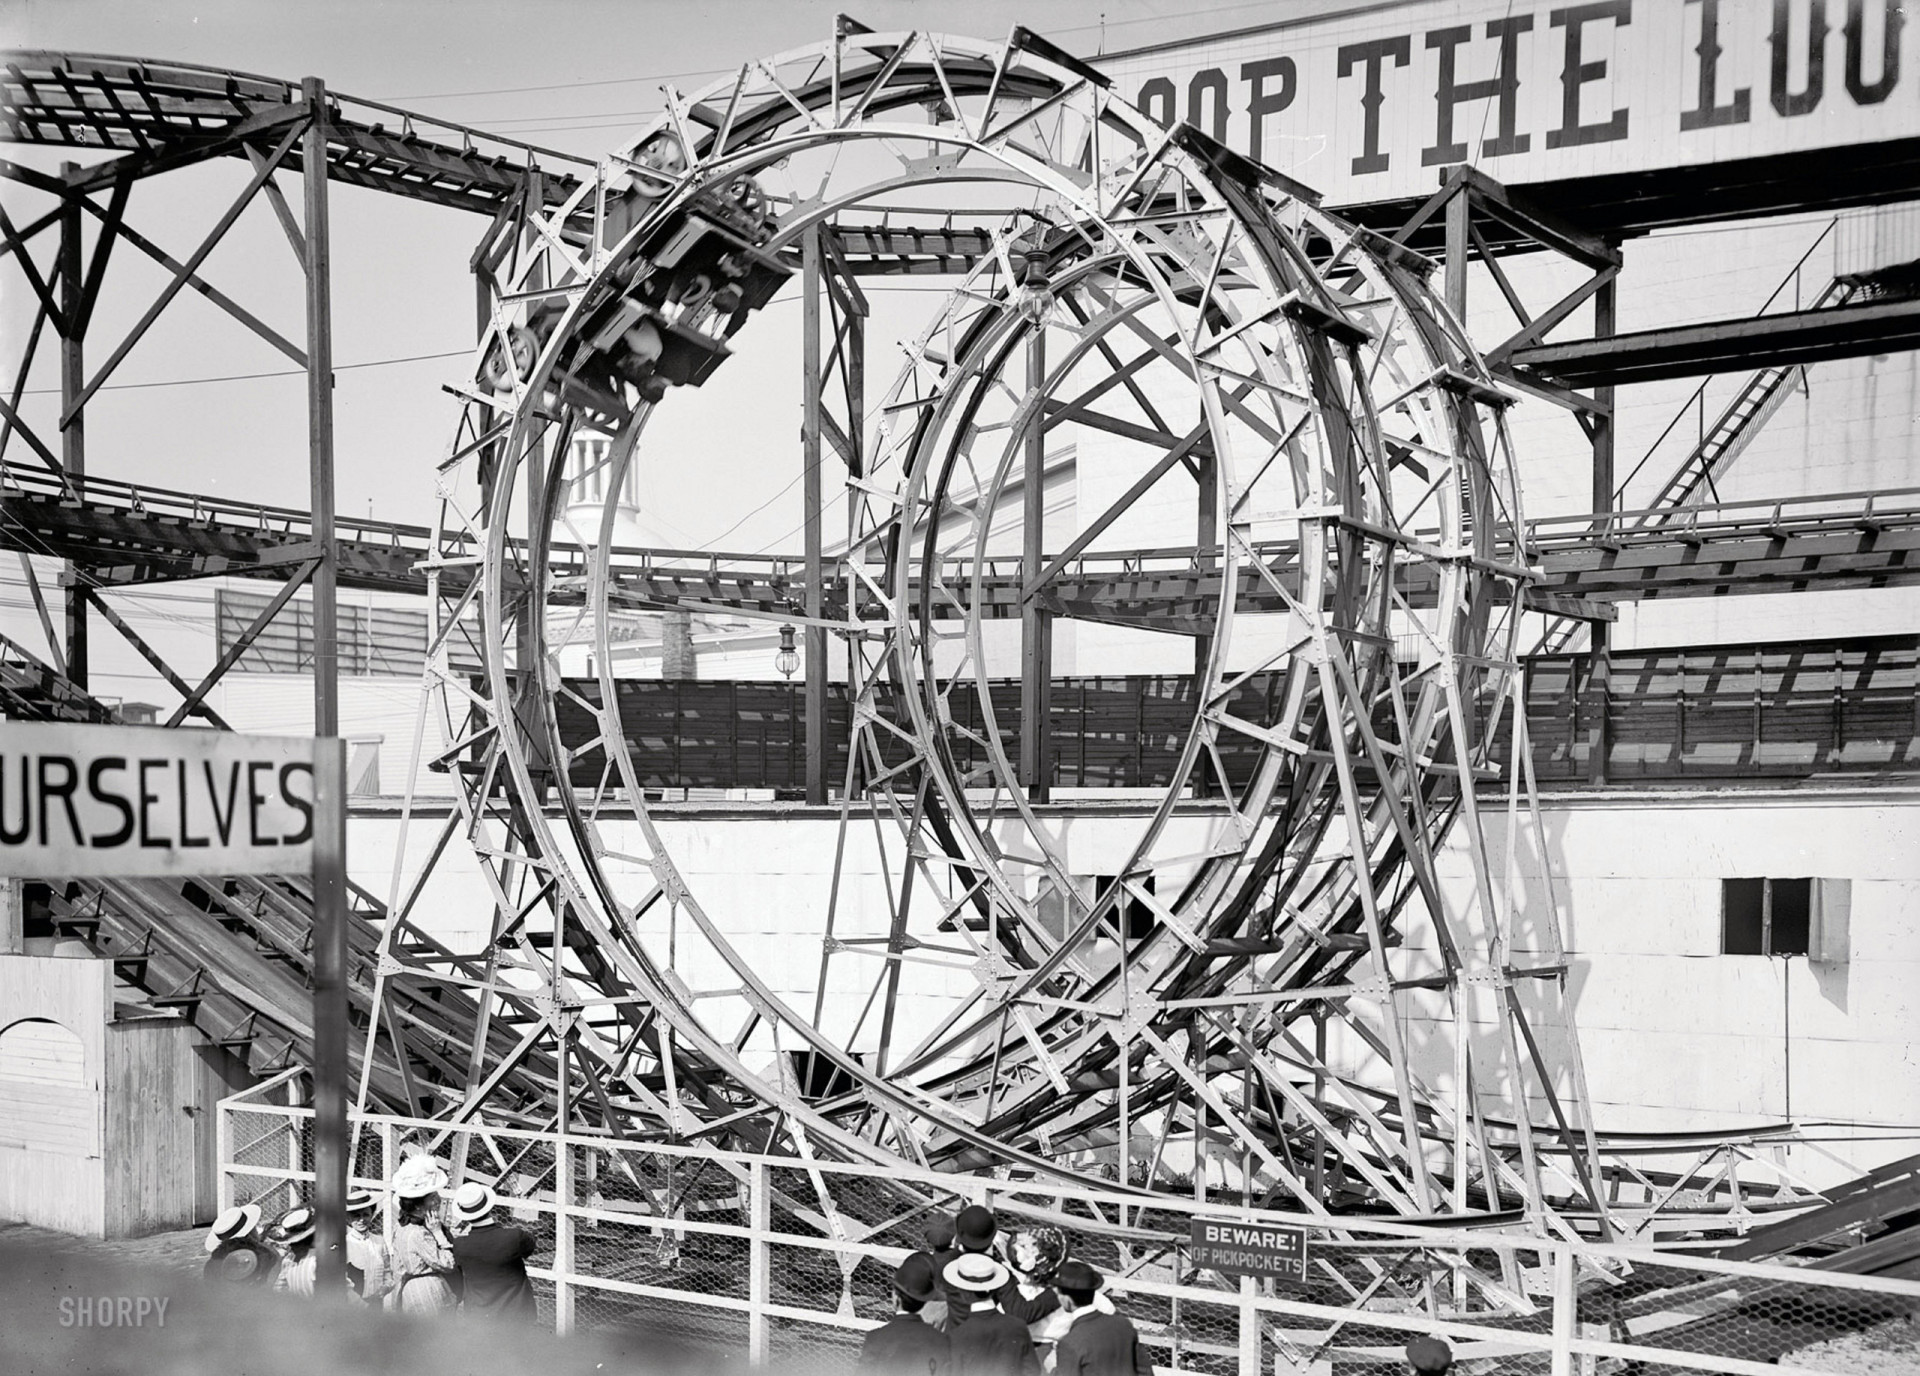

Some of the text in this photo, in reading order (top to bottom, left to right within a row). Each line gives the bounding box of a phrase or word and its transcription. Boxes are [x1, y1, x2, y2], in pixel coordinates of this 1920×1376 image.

[1337, 0, 1632, 176] THE
[1205, 1225, 1297, 1251] BEWARE!
[1193, 1246, 1303, 1275] OF PICKPOCKETS
